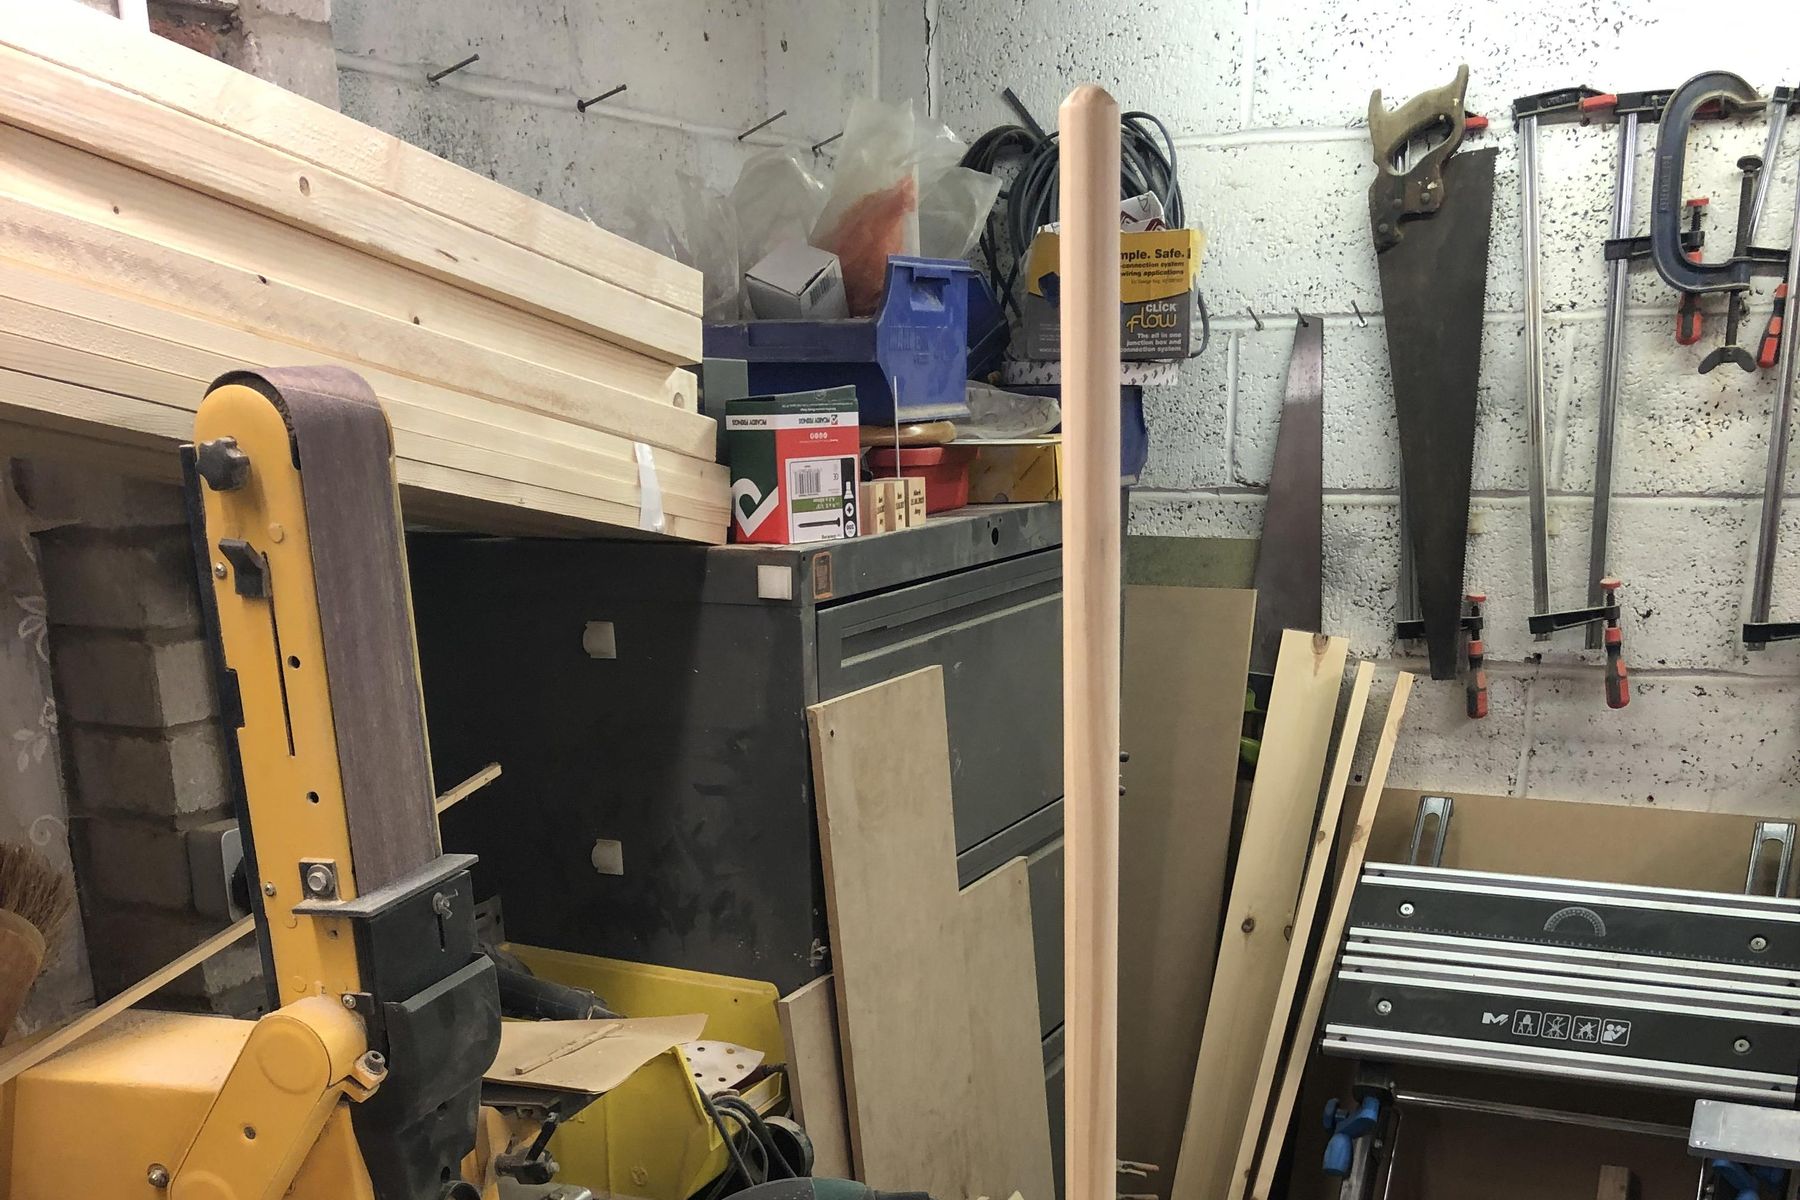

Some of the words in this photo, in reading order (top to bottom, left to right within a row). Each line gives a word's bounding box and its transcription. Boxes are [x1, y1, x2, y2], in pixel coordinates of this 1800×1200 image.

[1120, 250, 1150, 262] mple.
[1155, 248, 1185, 259] Safe.
[1143, 269, 1184, 277] applications
